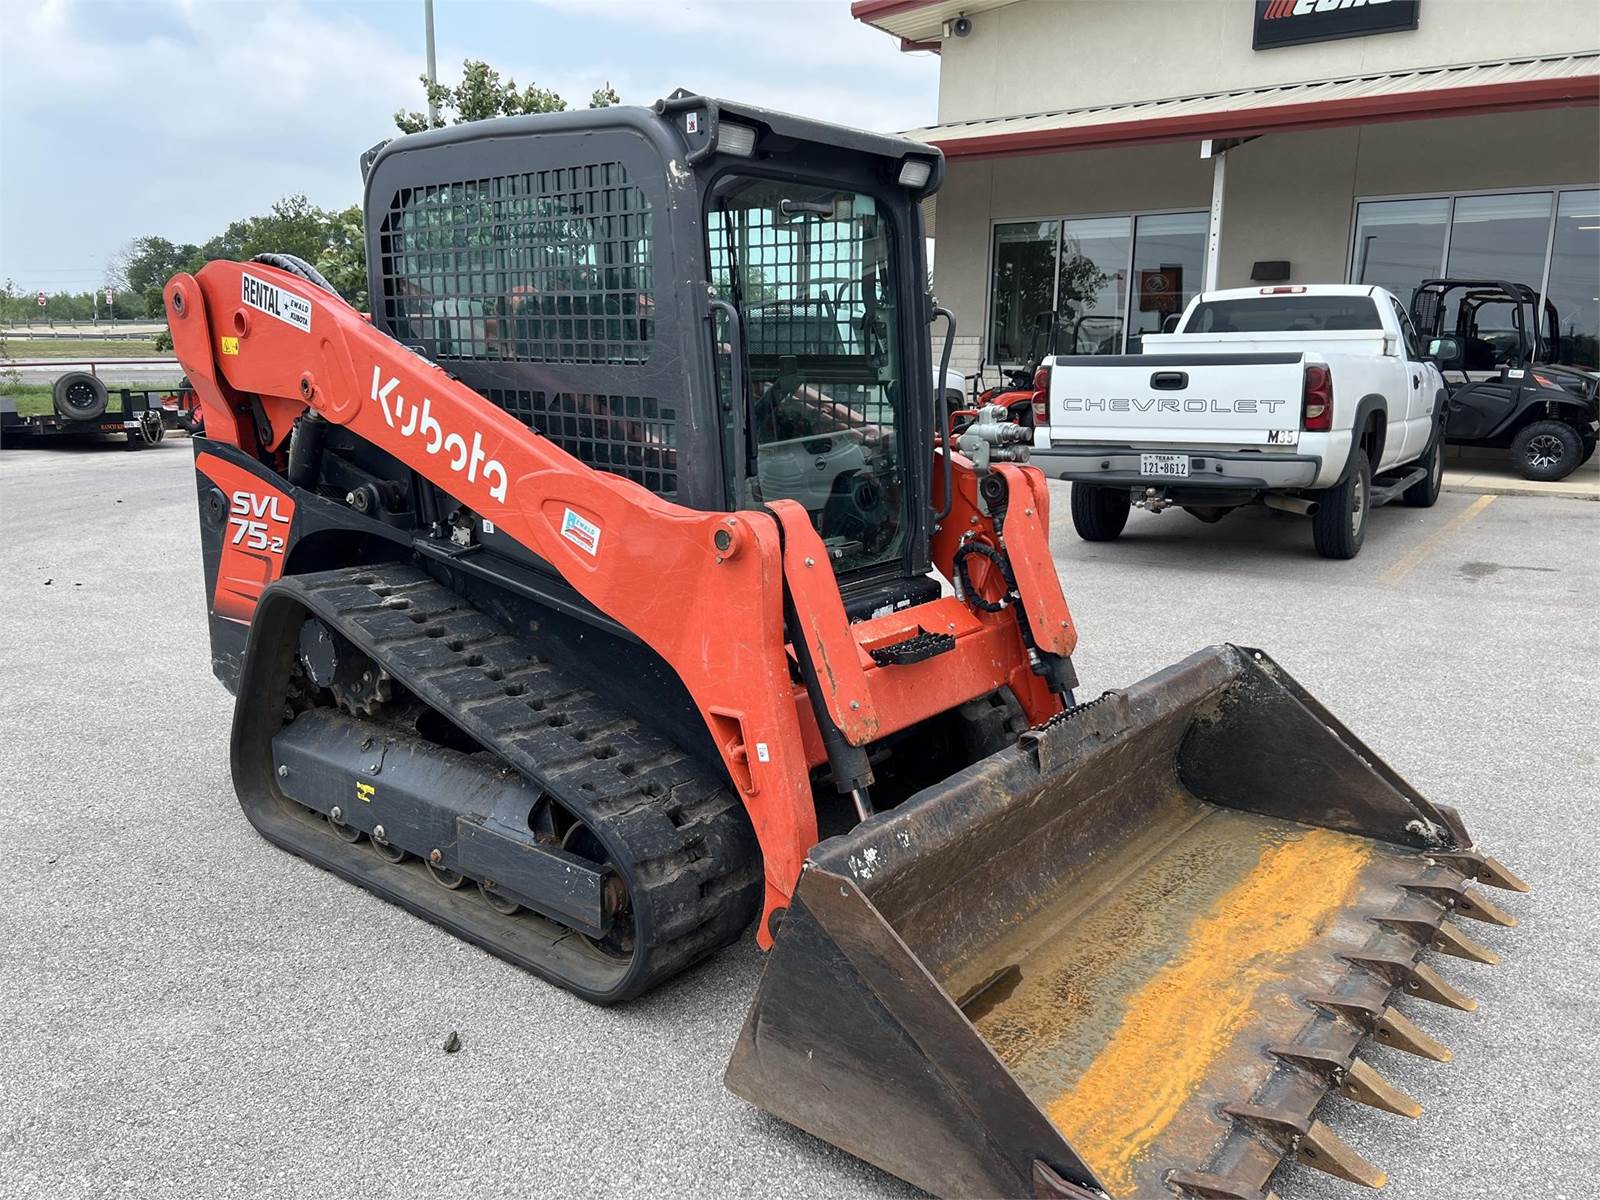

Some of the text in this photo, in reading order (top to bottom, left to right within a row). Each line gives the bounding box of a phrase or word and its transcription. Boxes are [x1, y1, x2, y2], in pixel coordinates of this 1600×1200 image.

[243, 276, 281, 317] RENTAL
[290, 299, 309, 313] EWALD
[290, 312, 308, 326] KUBOTA
[1063, 398, 1286, 414] CHEVROLET
[370, 364, 508, 504] Kubota
[1267, 430, 1294, 443] M35
[231, 490, 290, 523] SVL
[230, 517, 284, 554] 75-2
